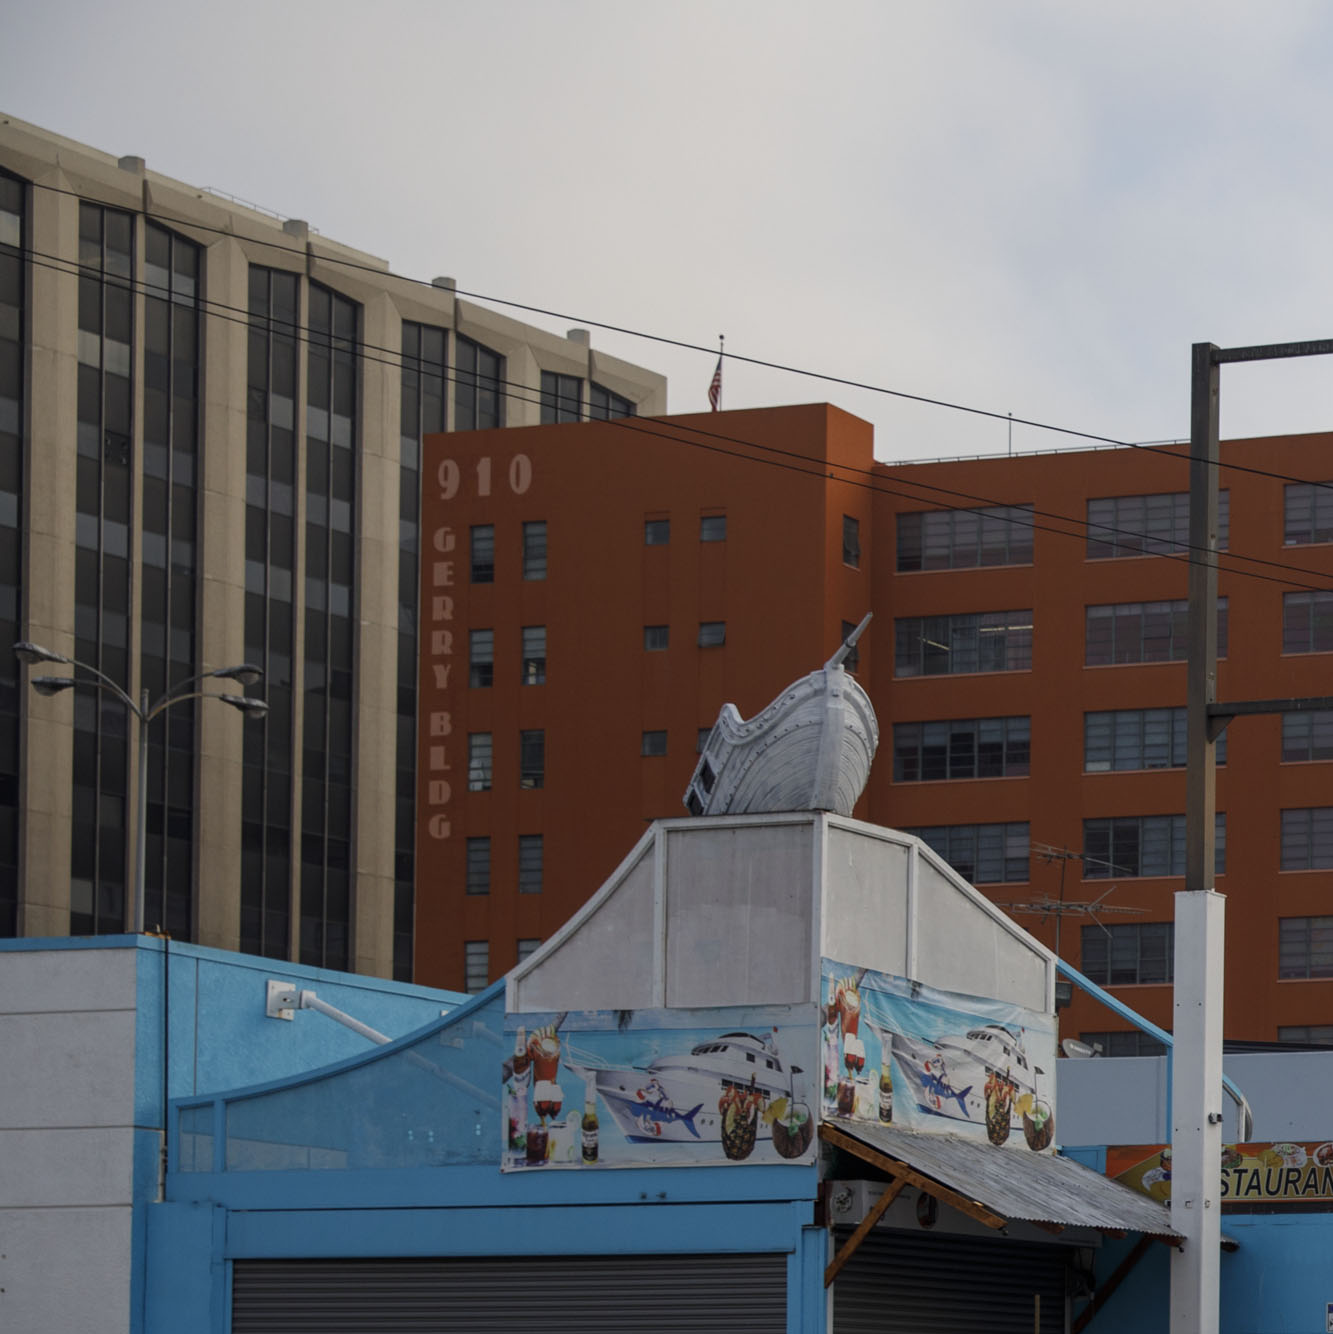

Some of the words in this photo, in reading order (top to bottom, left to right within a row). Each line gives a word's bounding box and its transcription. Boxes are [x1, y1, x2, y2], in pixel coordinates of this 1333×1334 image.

[438, 453, 532, 500] 910
[430, 527, 456, 690] GERRY
[427, 711, 453, 840] BLDG
